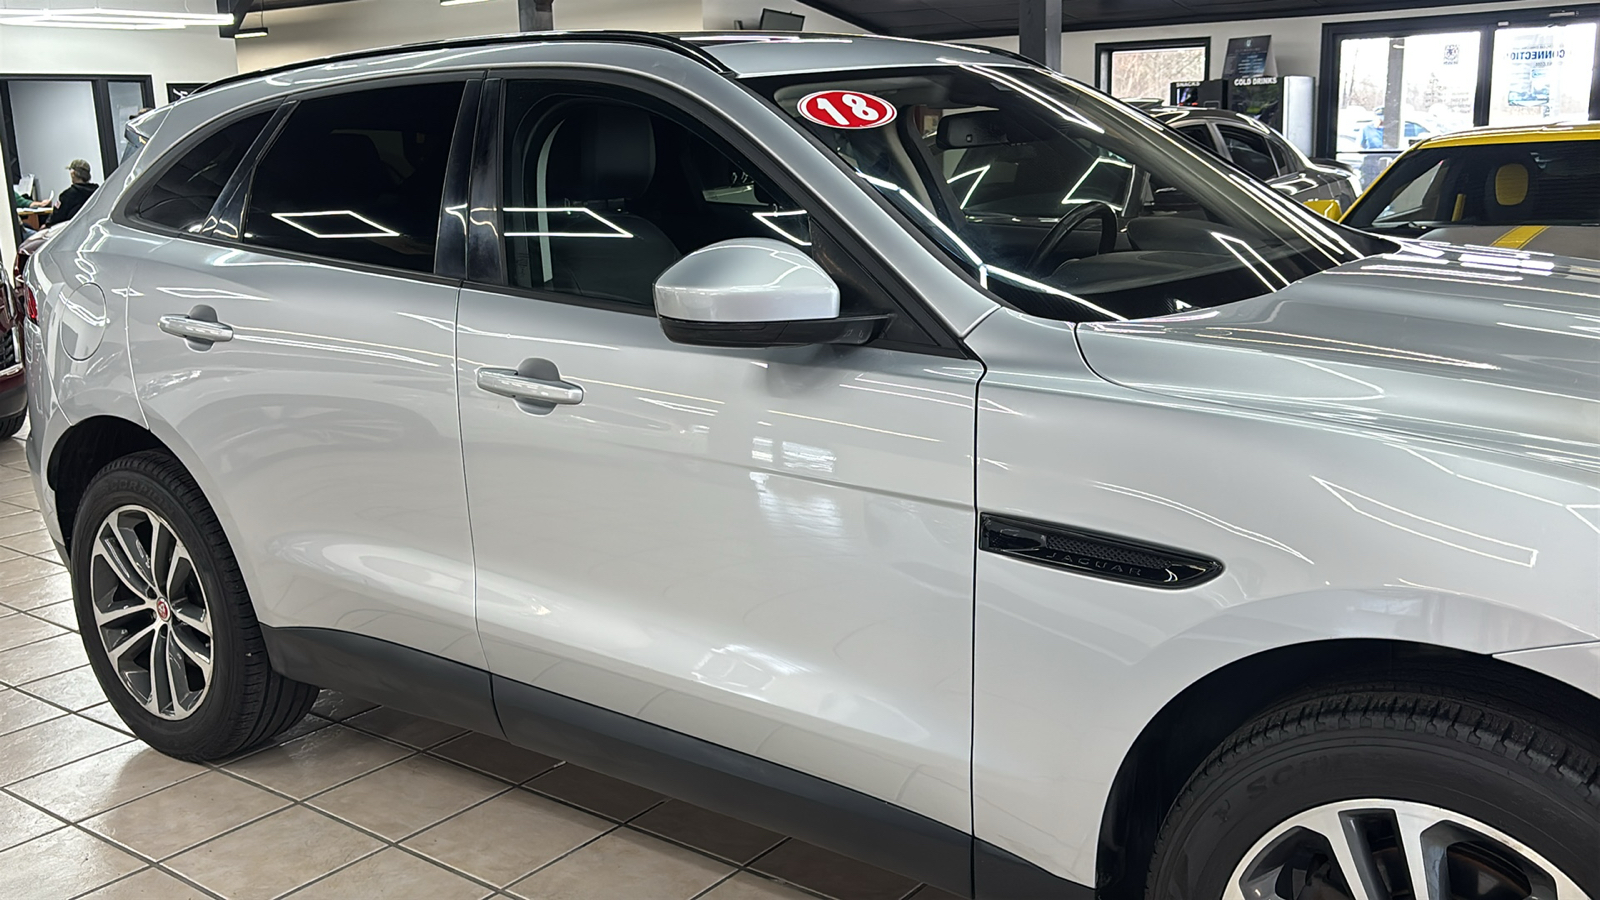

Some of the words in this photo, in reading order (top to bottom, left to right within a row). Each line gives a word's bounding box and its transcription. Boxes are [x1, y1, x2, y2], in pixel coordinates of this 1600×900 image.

[1234, 78, 1251, 86] COLD
[1252, 77, 1278, 85] DRINKS
[816, 93, 879, 126] 18
[1046, 552, 1142, 576] JAGUAR
